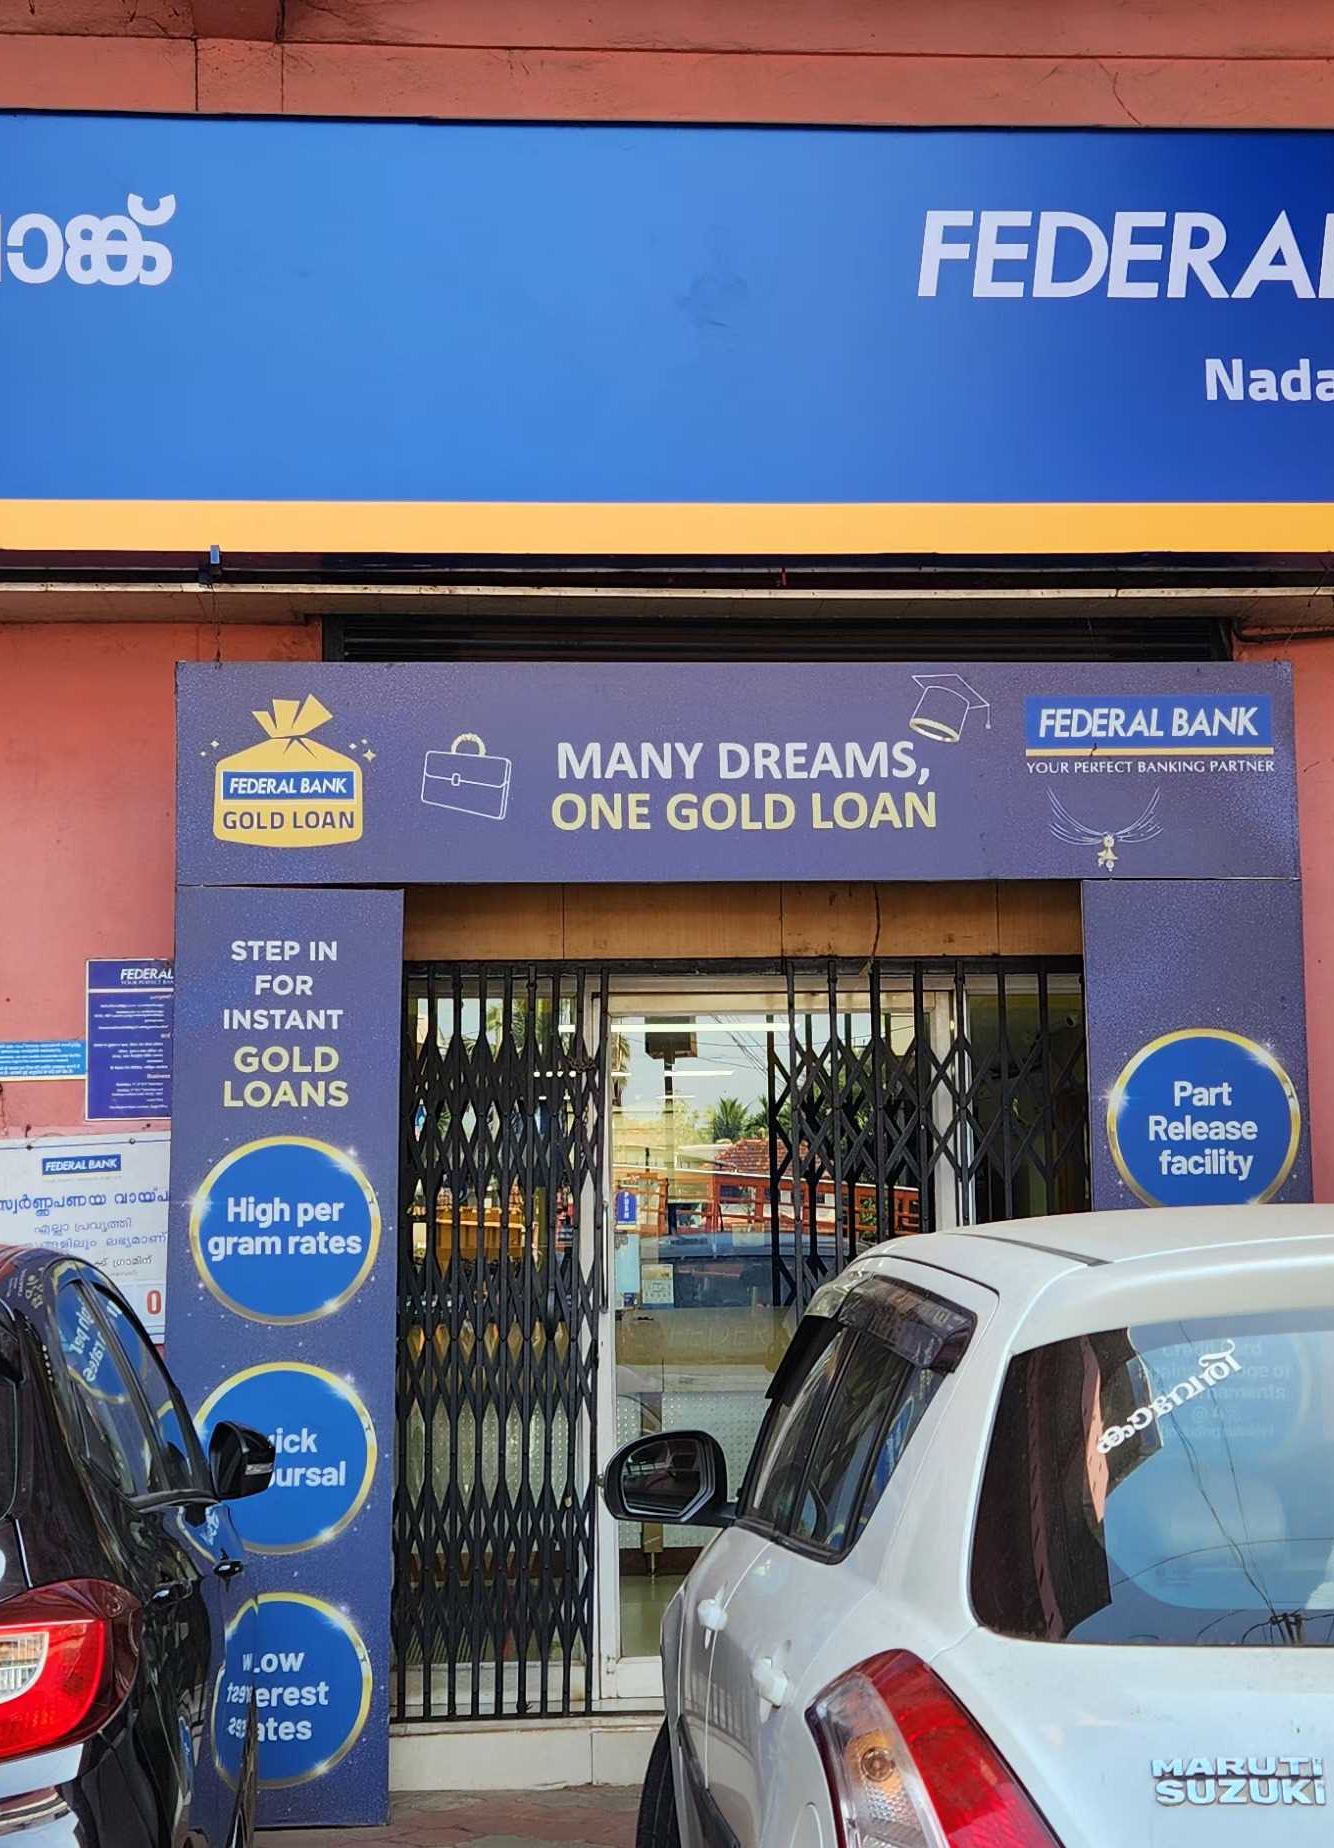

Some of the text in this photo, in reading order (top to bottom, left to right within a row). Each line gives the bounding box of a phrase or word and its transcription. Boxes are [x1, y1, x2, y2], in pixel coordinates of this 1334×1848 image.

[1039, 707, 1258, 737] FEDERAL BANK
[557, 741, 930, 785] MANY DREAMS,
[1027, 760, 1274, 773] YOUR PERFECT BANKING PARTNER
[229, 777, 347, 794] FEDERAL BANK
[223, 811, 354, 830] GOLD LOAN
[551, 792, 937, 831] ONE GOLD LOAN
[231, 941, 338, 961] STEP IN
[121, 968, 174, 980] FEDERAL
[255, 975, 313, 996] FOR
[223, 1010, 343, 1030] INSTANT
[234, 1046, 340, 1073] GOLD
[223, 1081, 349, 1107] LOANS
[1174, 1081, 1232, 1106] Part
[1149, 1116, 1258, 1141] Release
[45, 1158, 118, 1172] FEDERAL BANK
[1159, 1150, 1253, 1179] facility
[227, 1197, 344, 1228] High per
[207, 1231, 362, 1262] gram rates
[269, 1428, 317, 1454] ick
[269, 1461, 346, 1488] ursal
[253, 1652, 305, 1674] ow
[255, 1681, 329, 1708] erest
[257, 1717, 312, 1742] ates
[1152, 1756, 1323, 1778] MARUTI
[1155, 1778, 1326, 1807] SUZUKI
